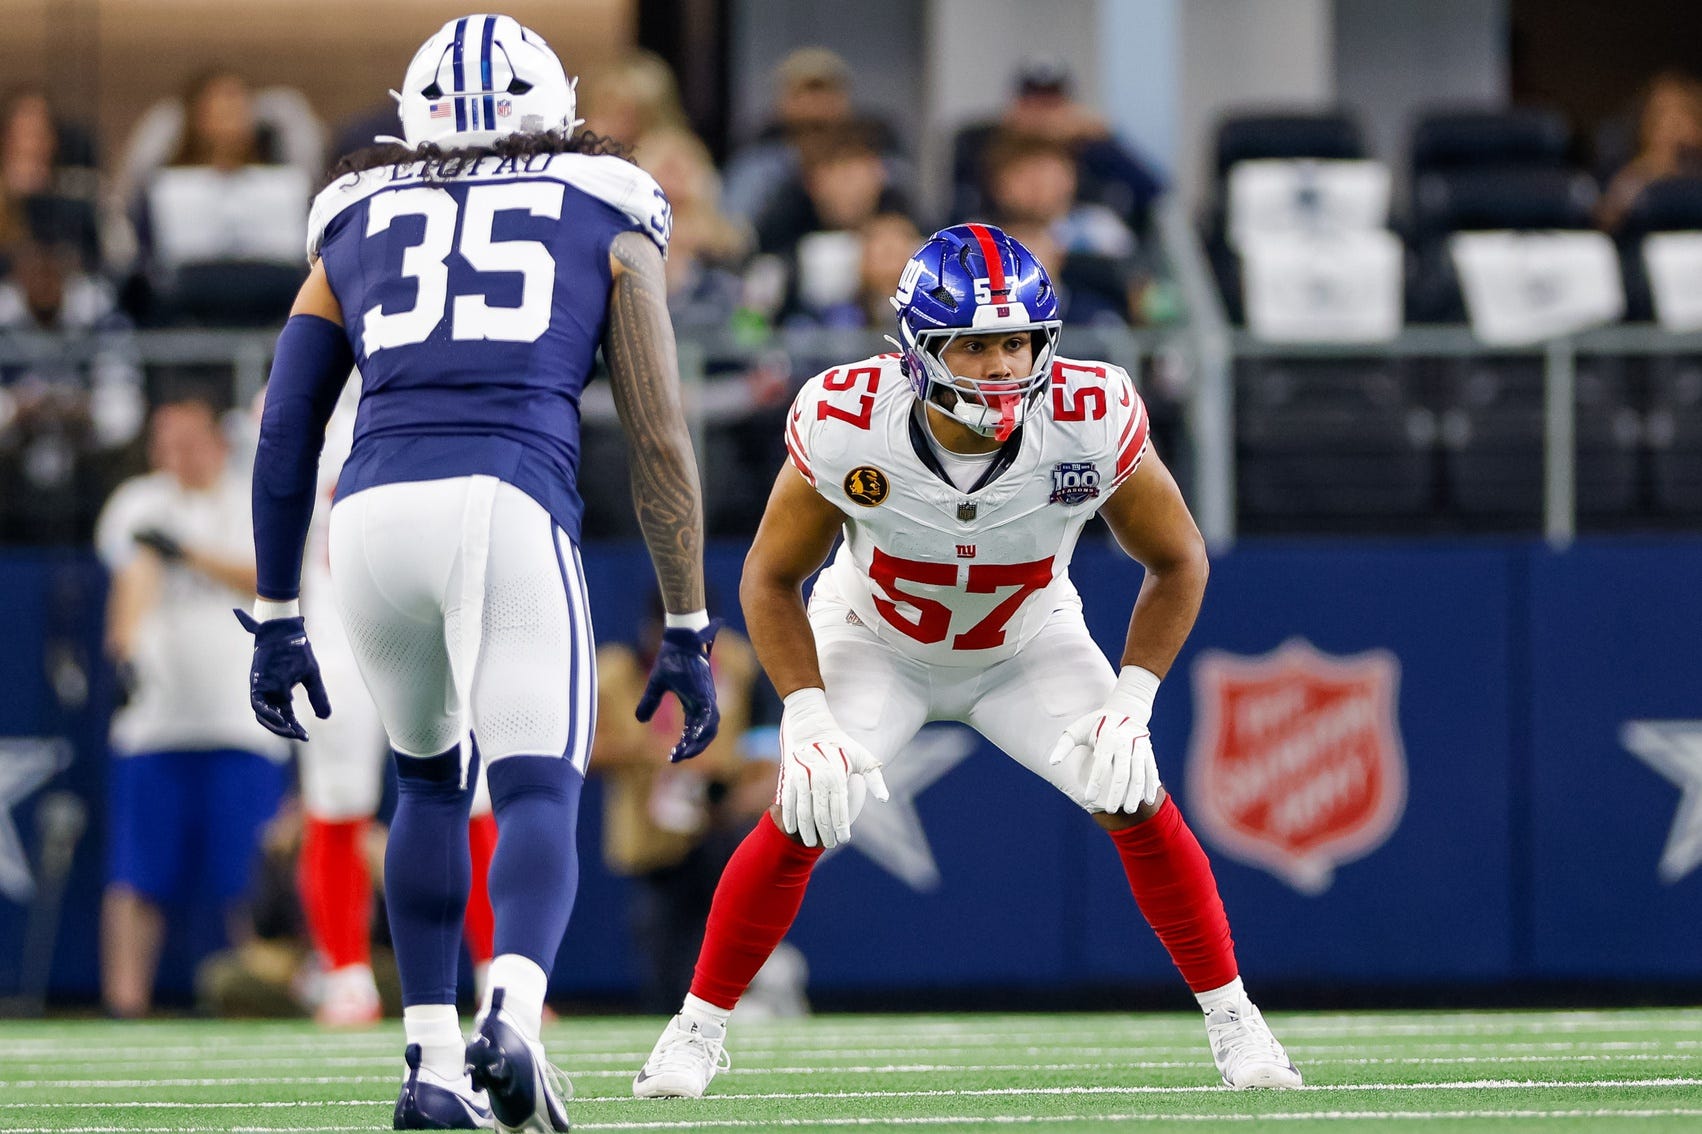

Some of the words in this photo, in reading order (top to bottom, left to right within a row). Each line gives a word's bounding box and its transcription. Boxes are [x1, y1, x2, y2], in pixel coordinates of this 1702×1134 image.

[361, 181, 565, 359] 35
[973, 275, 1019, 305] 57
[816, 367, 882, 431] 57
[1051, 361, 1107, 421] 57
[1053, 470, 1099, 492] 100
[868, 546, 1056, 651] 57
